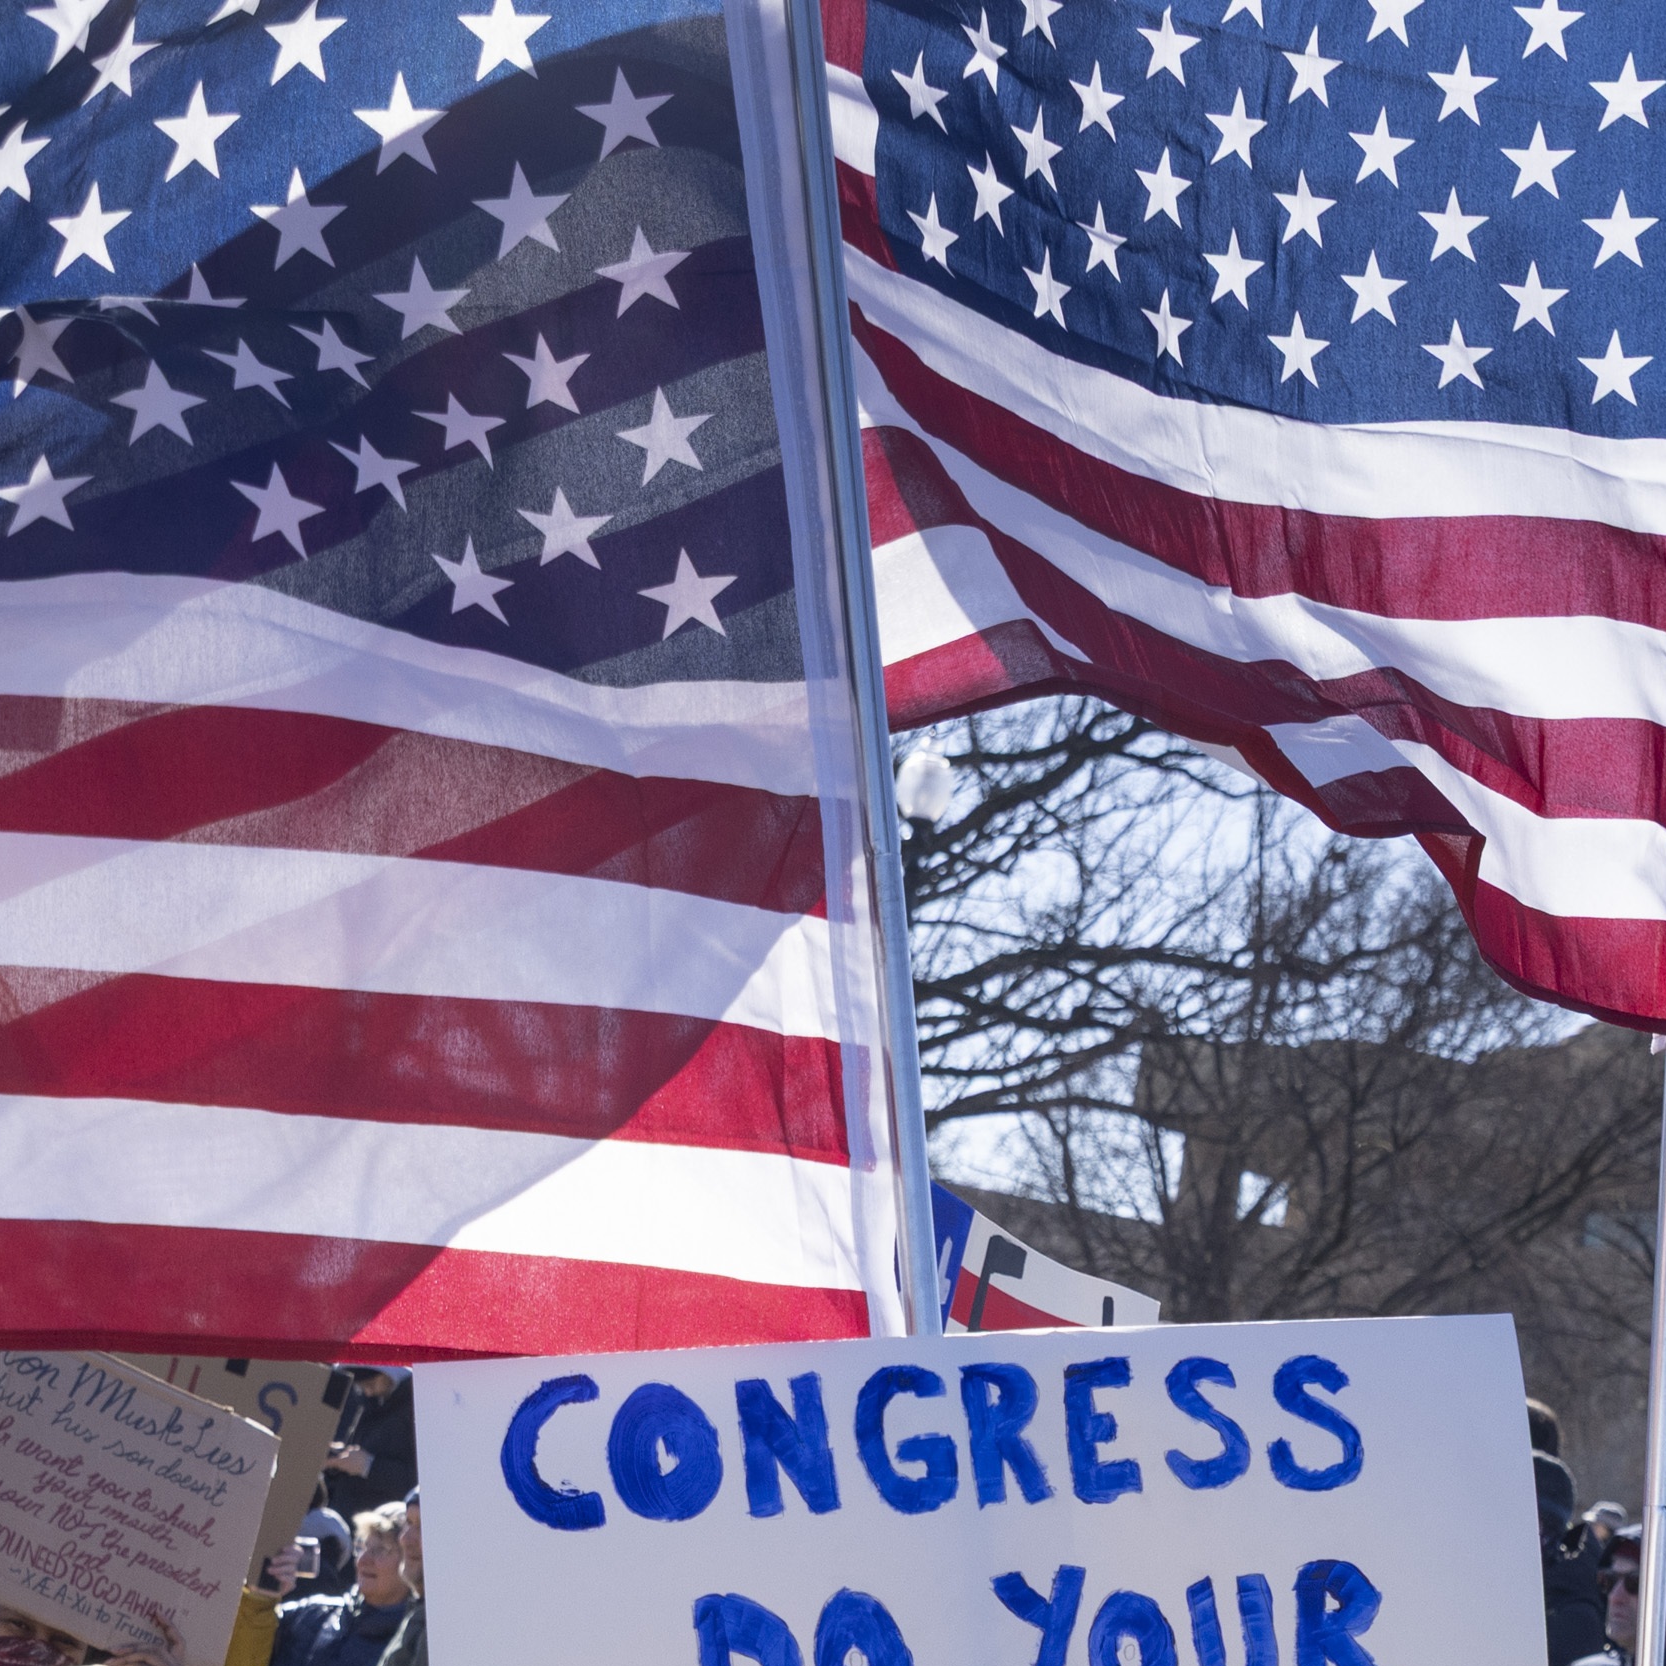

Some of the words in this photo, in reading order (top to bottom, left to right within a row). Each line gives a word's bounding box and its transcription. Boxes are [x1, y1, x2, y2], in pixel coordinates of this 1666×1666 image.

[51, 1401, 100, 1444] his
[102, 1440, 154, 1472] son
[68, 1361, 184, 1446] Musk
[183, 1418, 257, 1476] Lies
[500, 1354, 1365, 1531] CONGRESS
[15, 1437, 85, 1477] want
[84, 1472, 132, 1503] you
[132, 1488, 158, 1513] to
[154, 1503, 216, 1548] shush
[33, 1471, 99, 1510] your
[99, 1504, 178, 1551] mouth
[20, 1540, 69, 1580] NEED
[69, 1563, 94, 1591] TO
[92, 1575, 122, 1605] GO
[100, 1528, 131, 1559] the
[127, 1550, 221, 1600] president
[96, 1603, 112, 1625] to
